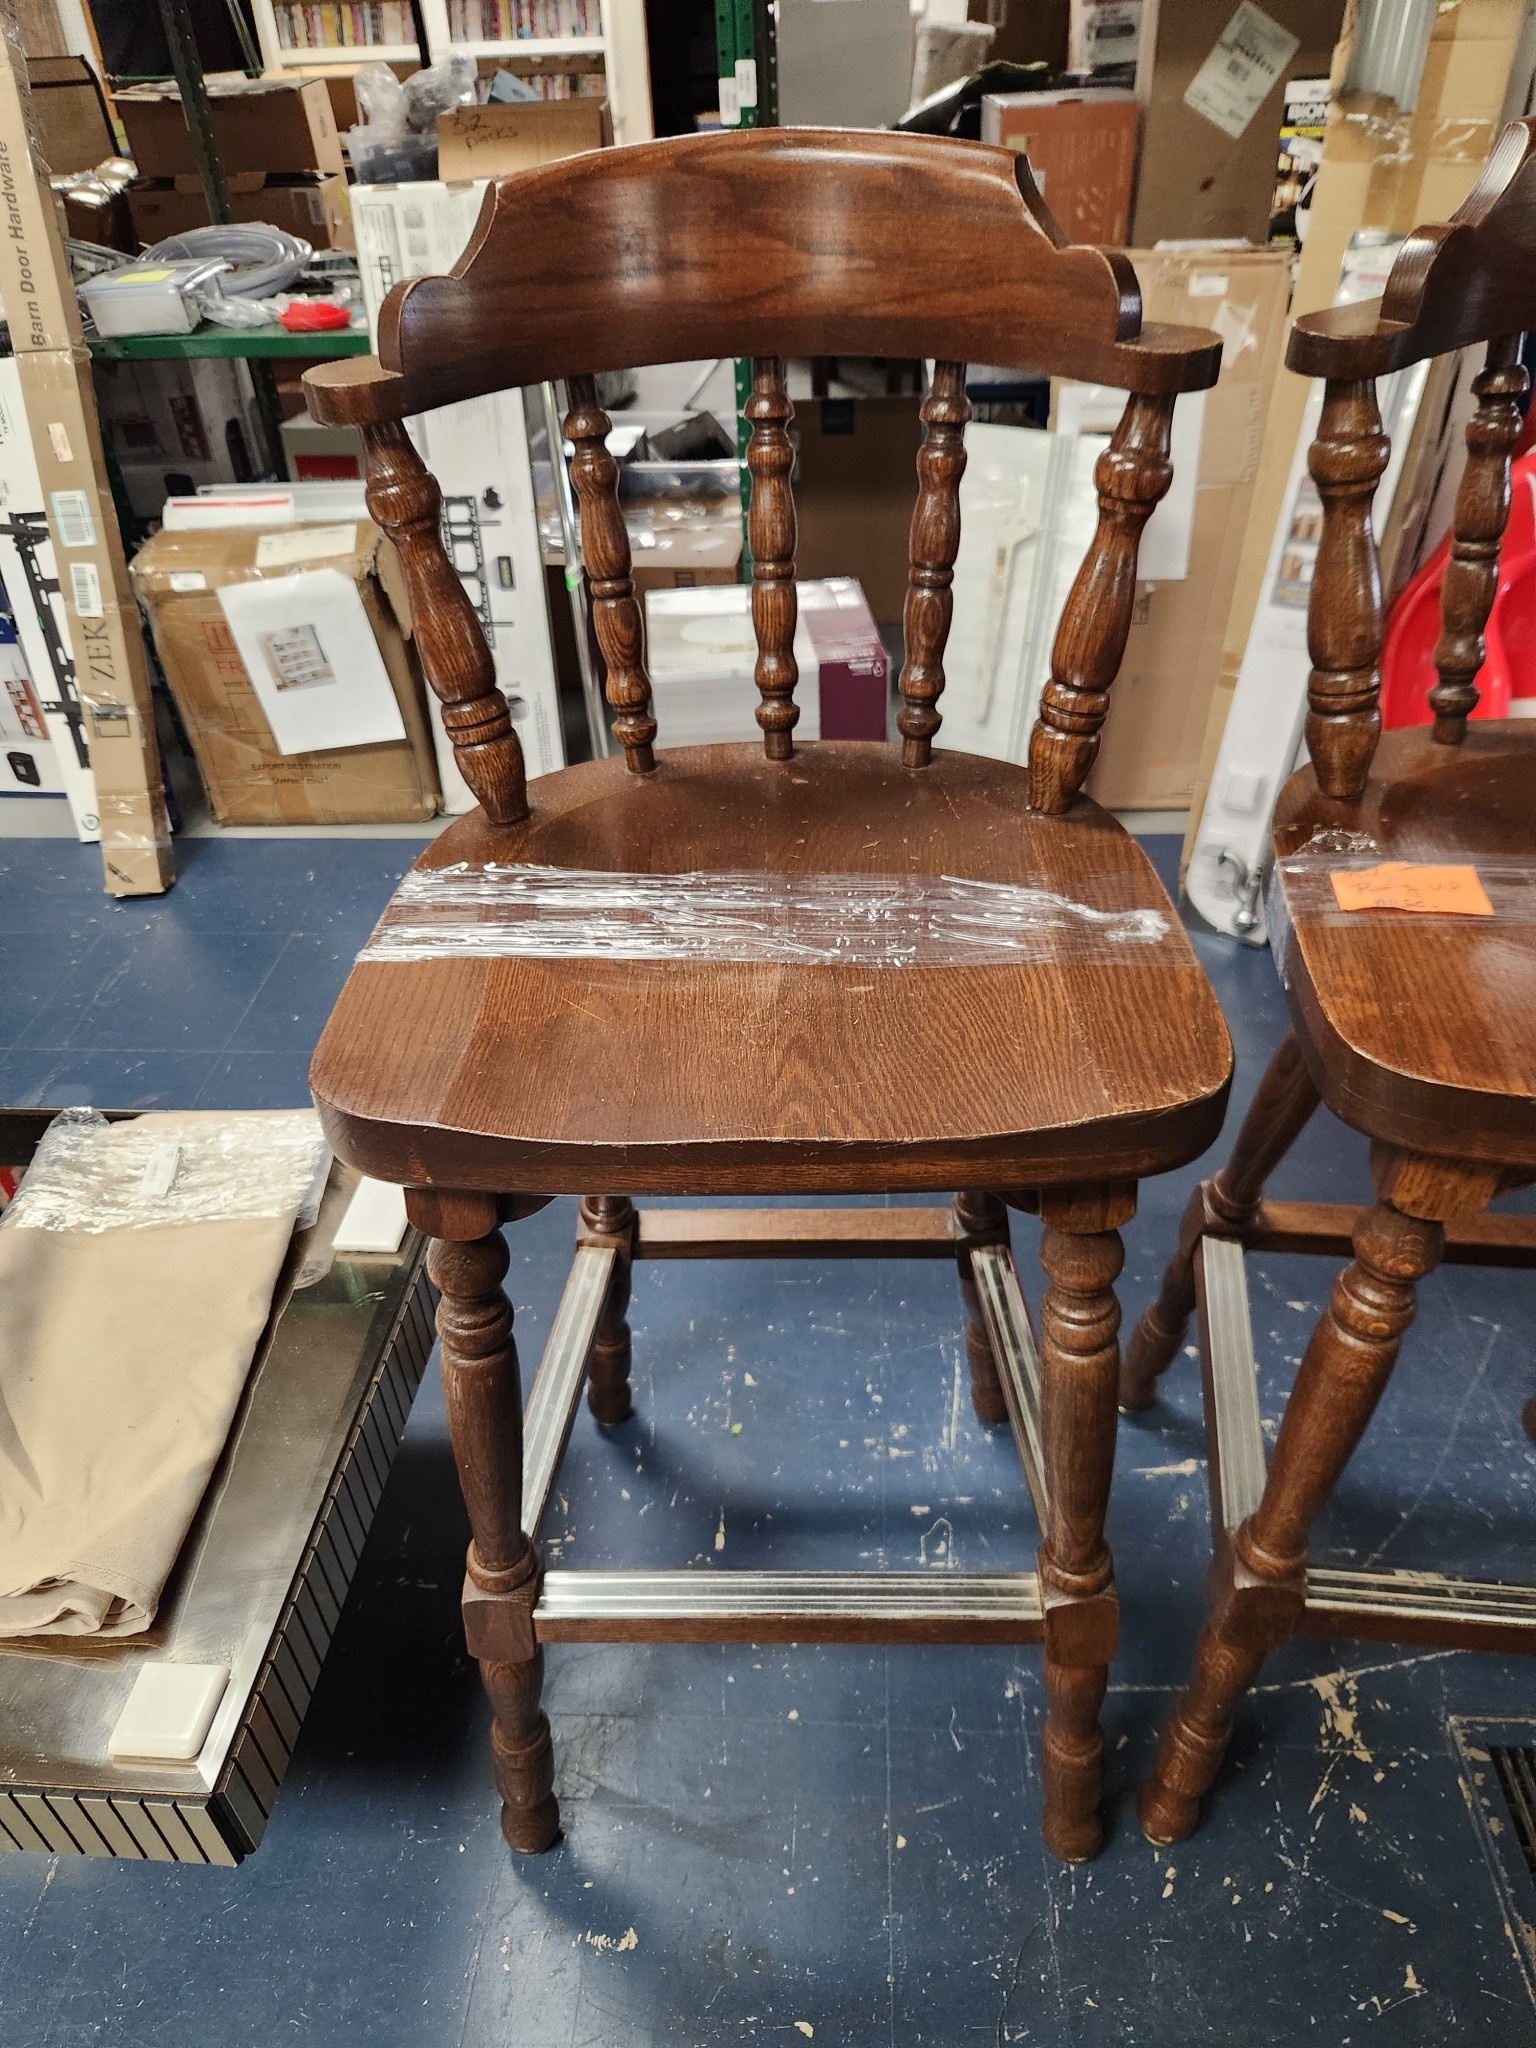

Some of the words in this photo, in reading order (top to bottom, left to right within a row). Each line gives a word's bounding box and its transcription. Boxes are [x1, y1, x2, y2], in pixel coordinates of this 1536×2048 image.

[0, 141, 24, 240] Hardware
[16, 246, 36, 294] Door
[26, 301, 47, 347] Barn
[82, 617, 116, 681] ZEK
